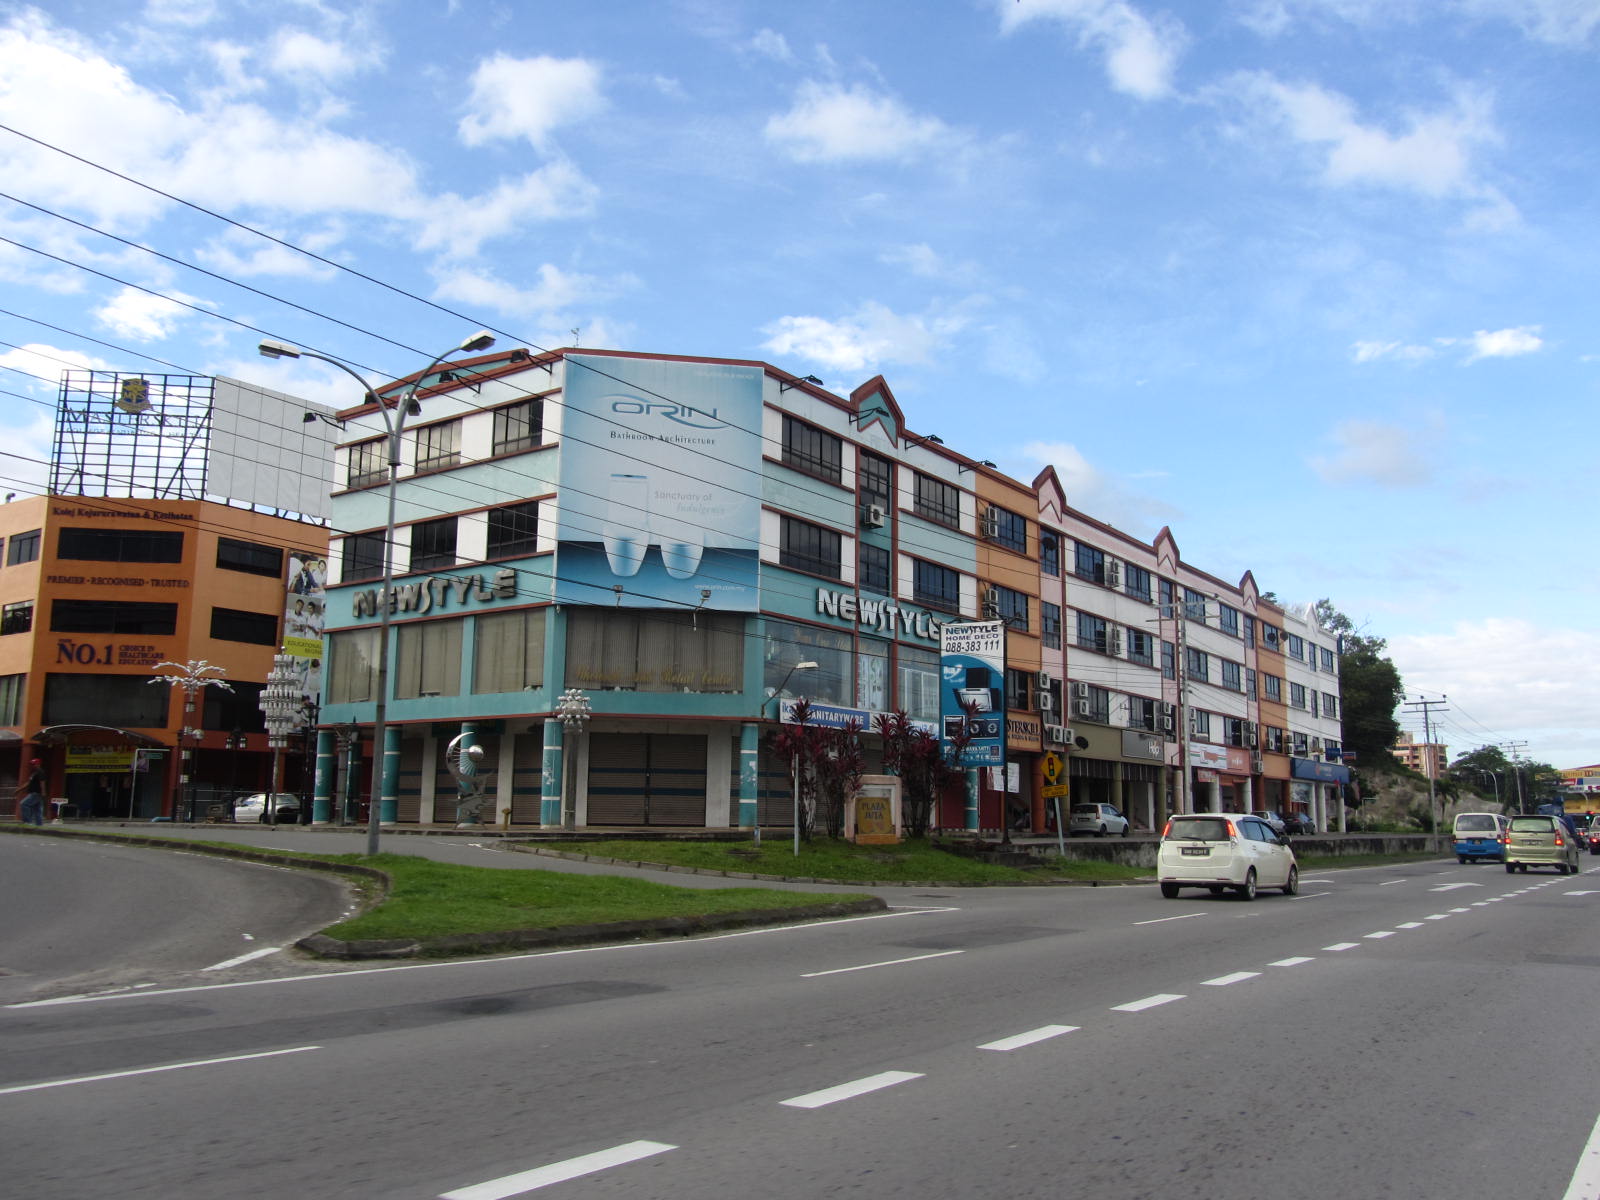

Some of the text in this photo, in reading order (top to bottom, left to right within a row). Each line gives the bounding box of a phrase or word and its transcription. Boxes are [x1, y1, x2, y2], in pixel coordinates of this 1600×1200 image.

[612, 402, 720, 423] ORIN
[47, 575, 85, 585] PREMIER
[151, 578, 190, 588] TRUSTED
[352, 568, 516, 618] NEWSTYLE
[816, 588, 940, 641] NEWSTYLE
[945, 625, 998, 635] NEWSTYLE
[56, 643, 113, 665] NO.1
[945, 640, 1000, 653] 088-383 111
[809, 711, 864, 725] ANITARYWARE
